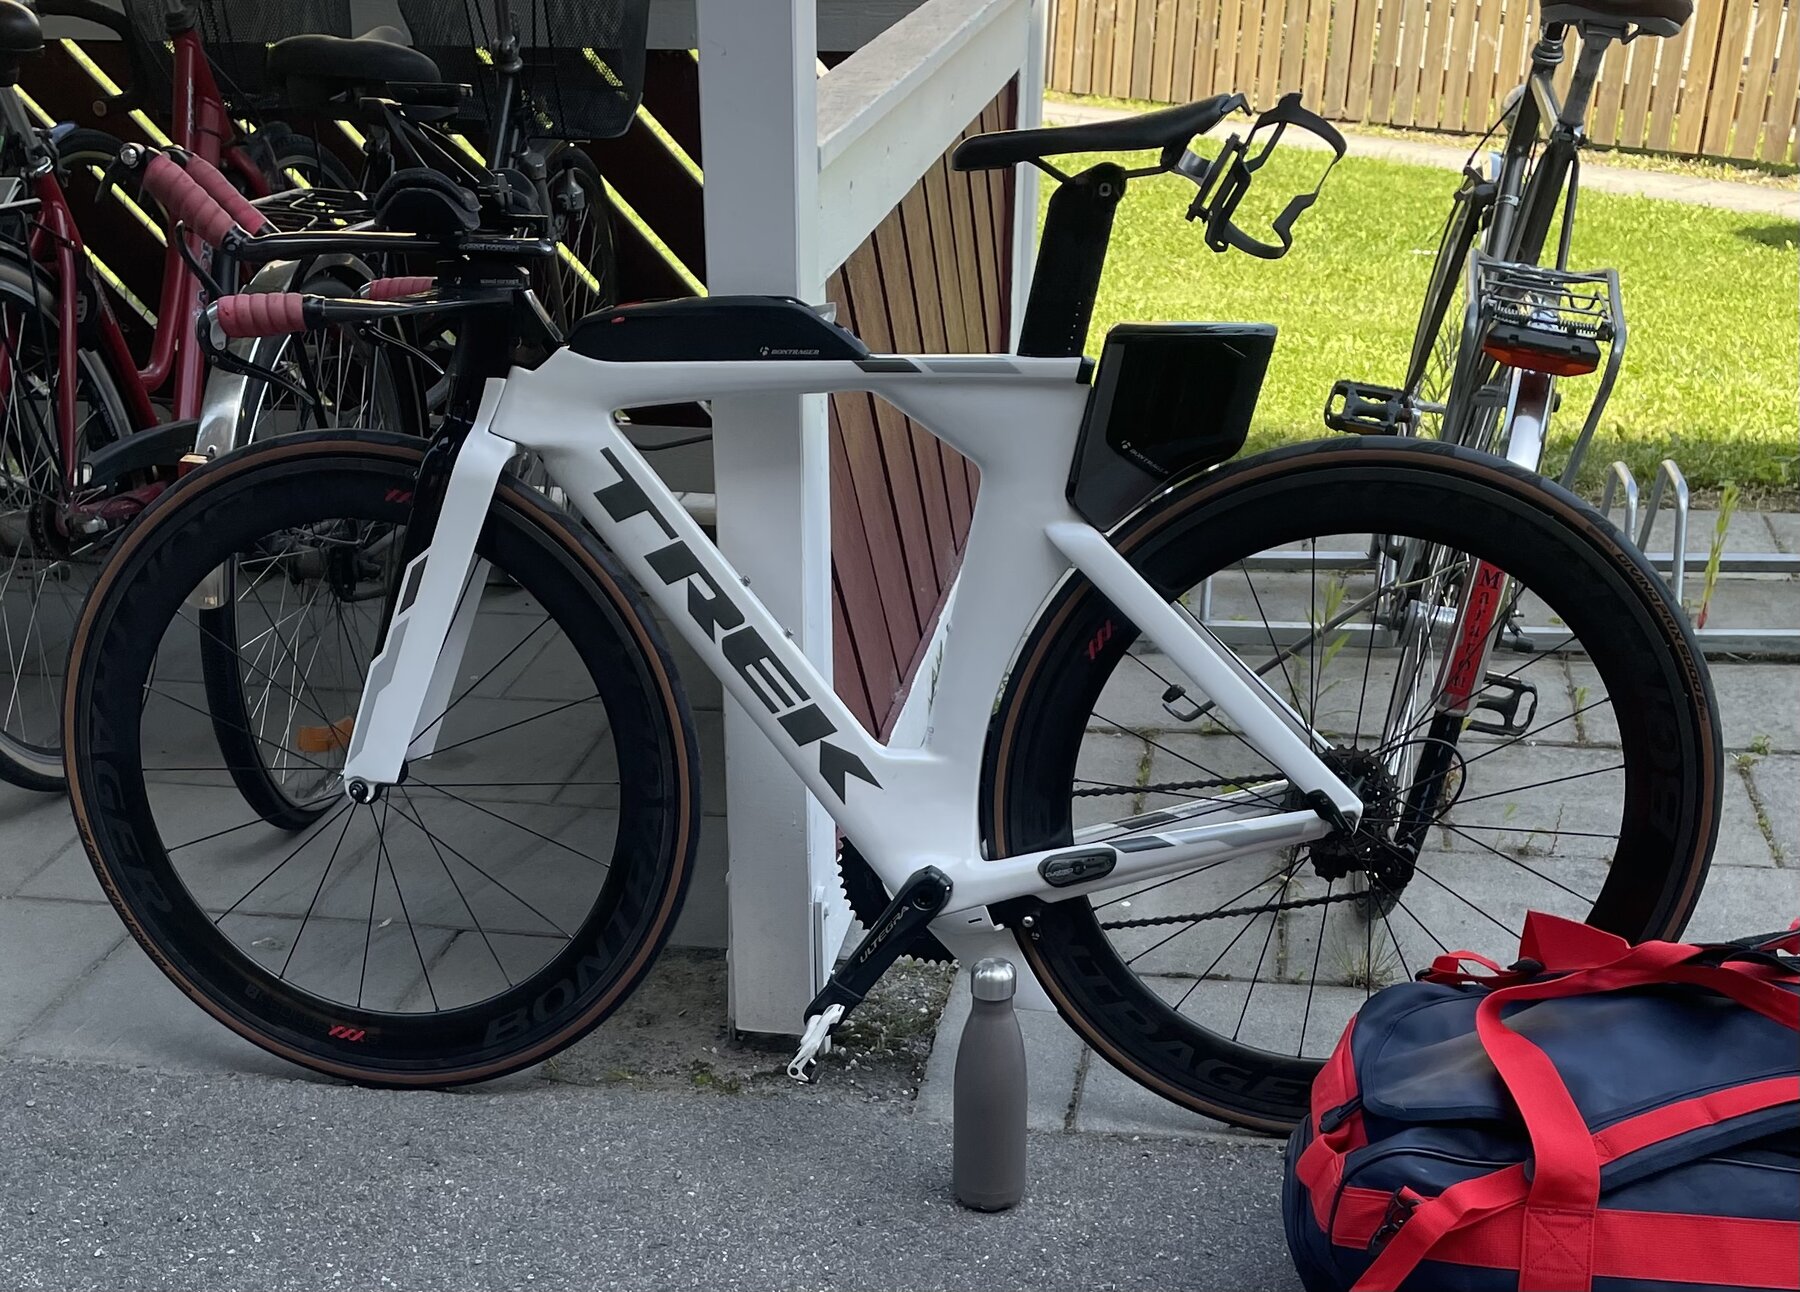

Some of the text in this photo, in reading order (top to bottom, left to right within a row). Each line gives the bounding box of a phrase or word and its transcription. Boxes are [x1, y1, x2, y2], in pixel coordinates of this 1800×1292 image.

[593, 447, 883, 805] TREK
[1655, 602, 1684, 642] PRIX
[860, 905, 910, 963] ULTEGRA
